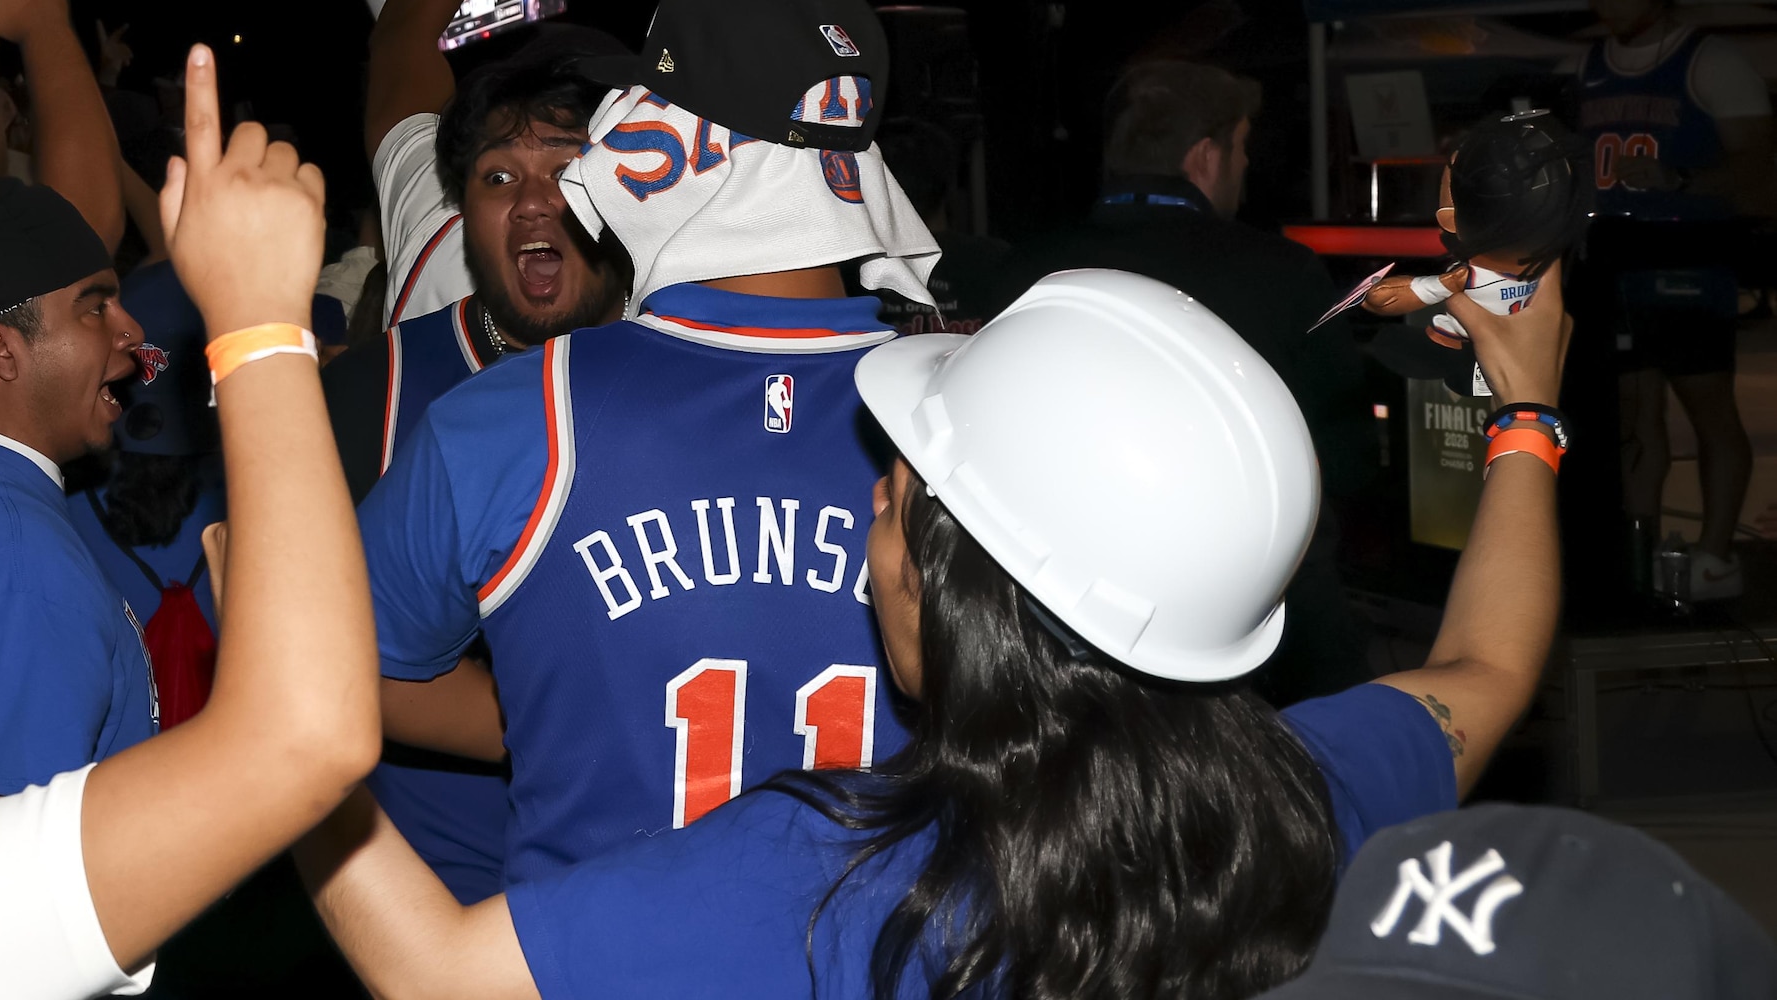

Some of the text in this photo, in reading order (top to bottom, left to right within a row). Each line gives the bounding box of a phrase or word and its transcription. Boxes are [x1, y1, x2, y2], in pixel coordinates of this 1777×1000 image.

[1424, 402, 1488, 436] FINALS
[573, 497, 874, 621] BRUNS
[664, 657, 878, 831] 11
[1370, 839, 1524, 956] NY
